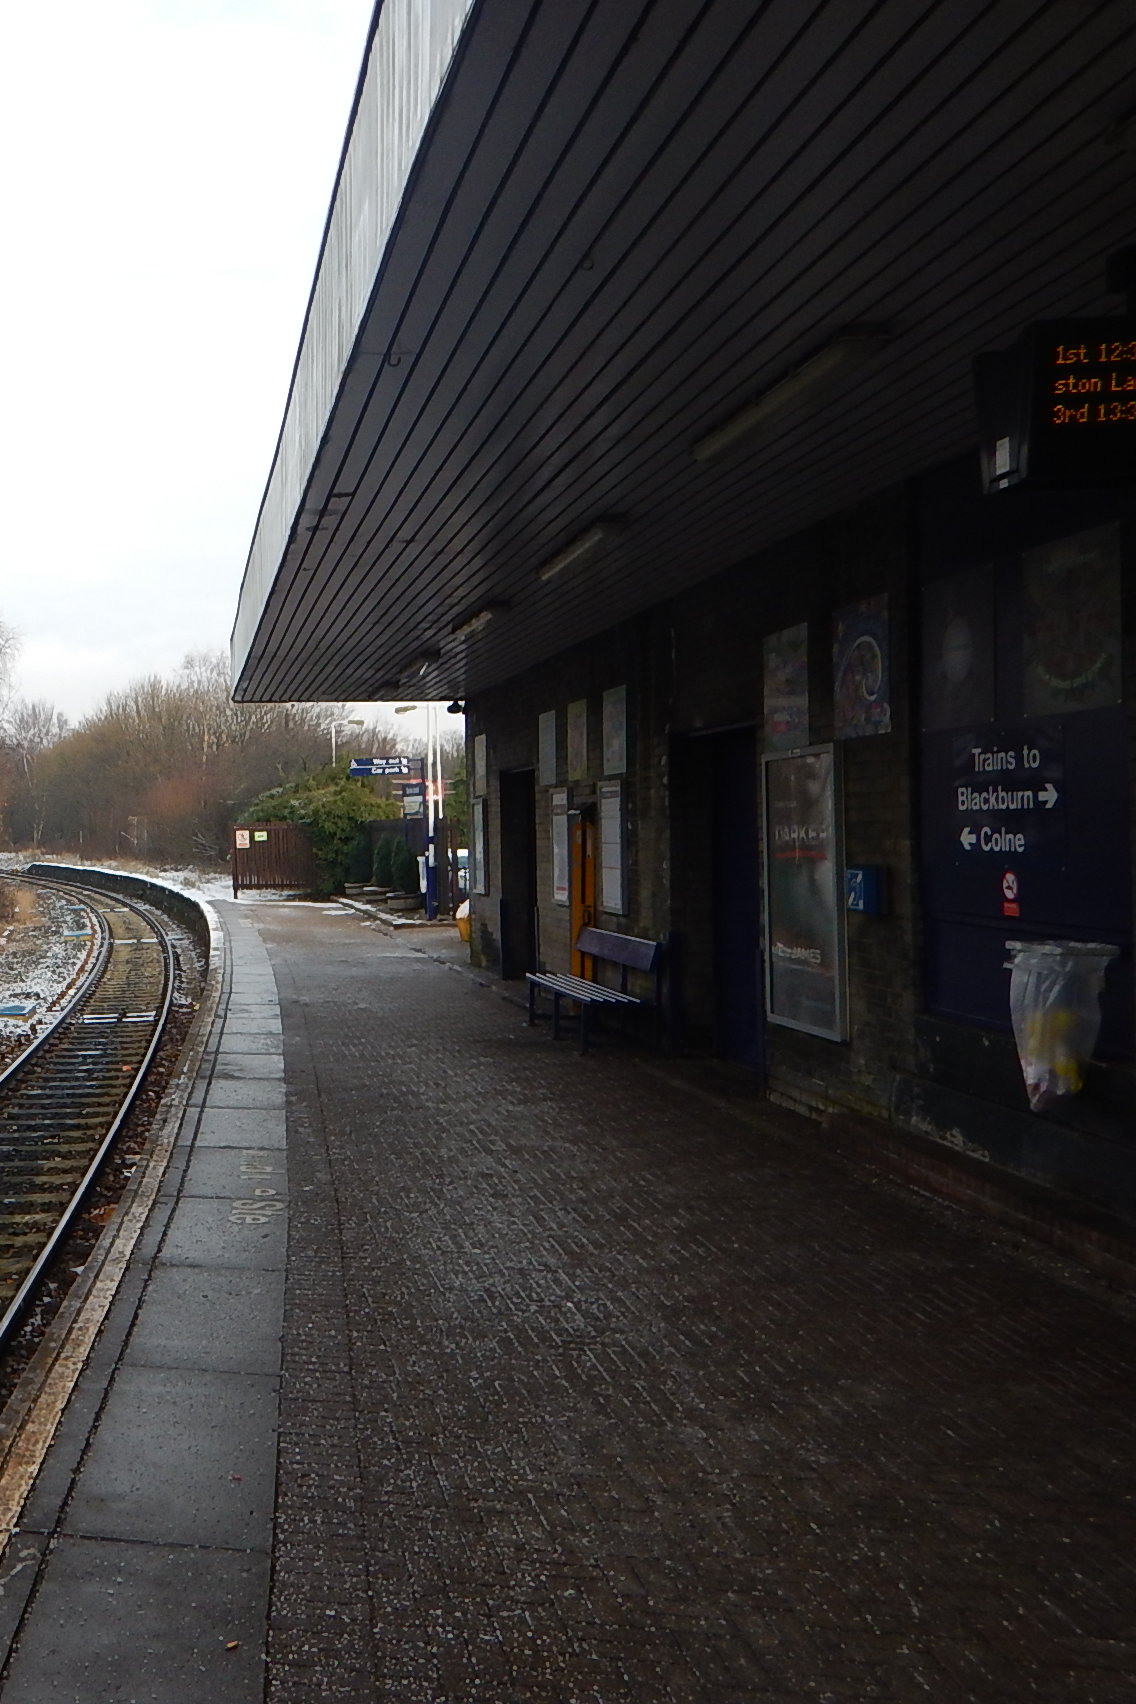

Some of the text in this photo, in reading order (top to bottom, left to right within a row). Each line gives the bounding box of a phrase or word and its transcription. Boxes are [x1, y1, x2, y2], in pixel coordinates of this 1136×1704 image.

[1055, 343, 1090, 364] 1st
[1053, 373, 1101, 394] ston
[1052, 403, 1089, 423] 3rd
[372, 758, 387, 766] Way
[971, 744, 1040, 772] Trains to
[384, 766, 400, 775] park
[957, 785, 1034, 811] Blackburn
[980, 826, 1025, 852] Colne
